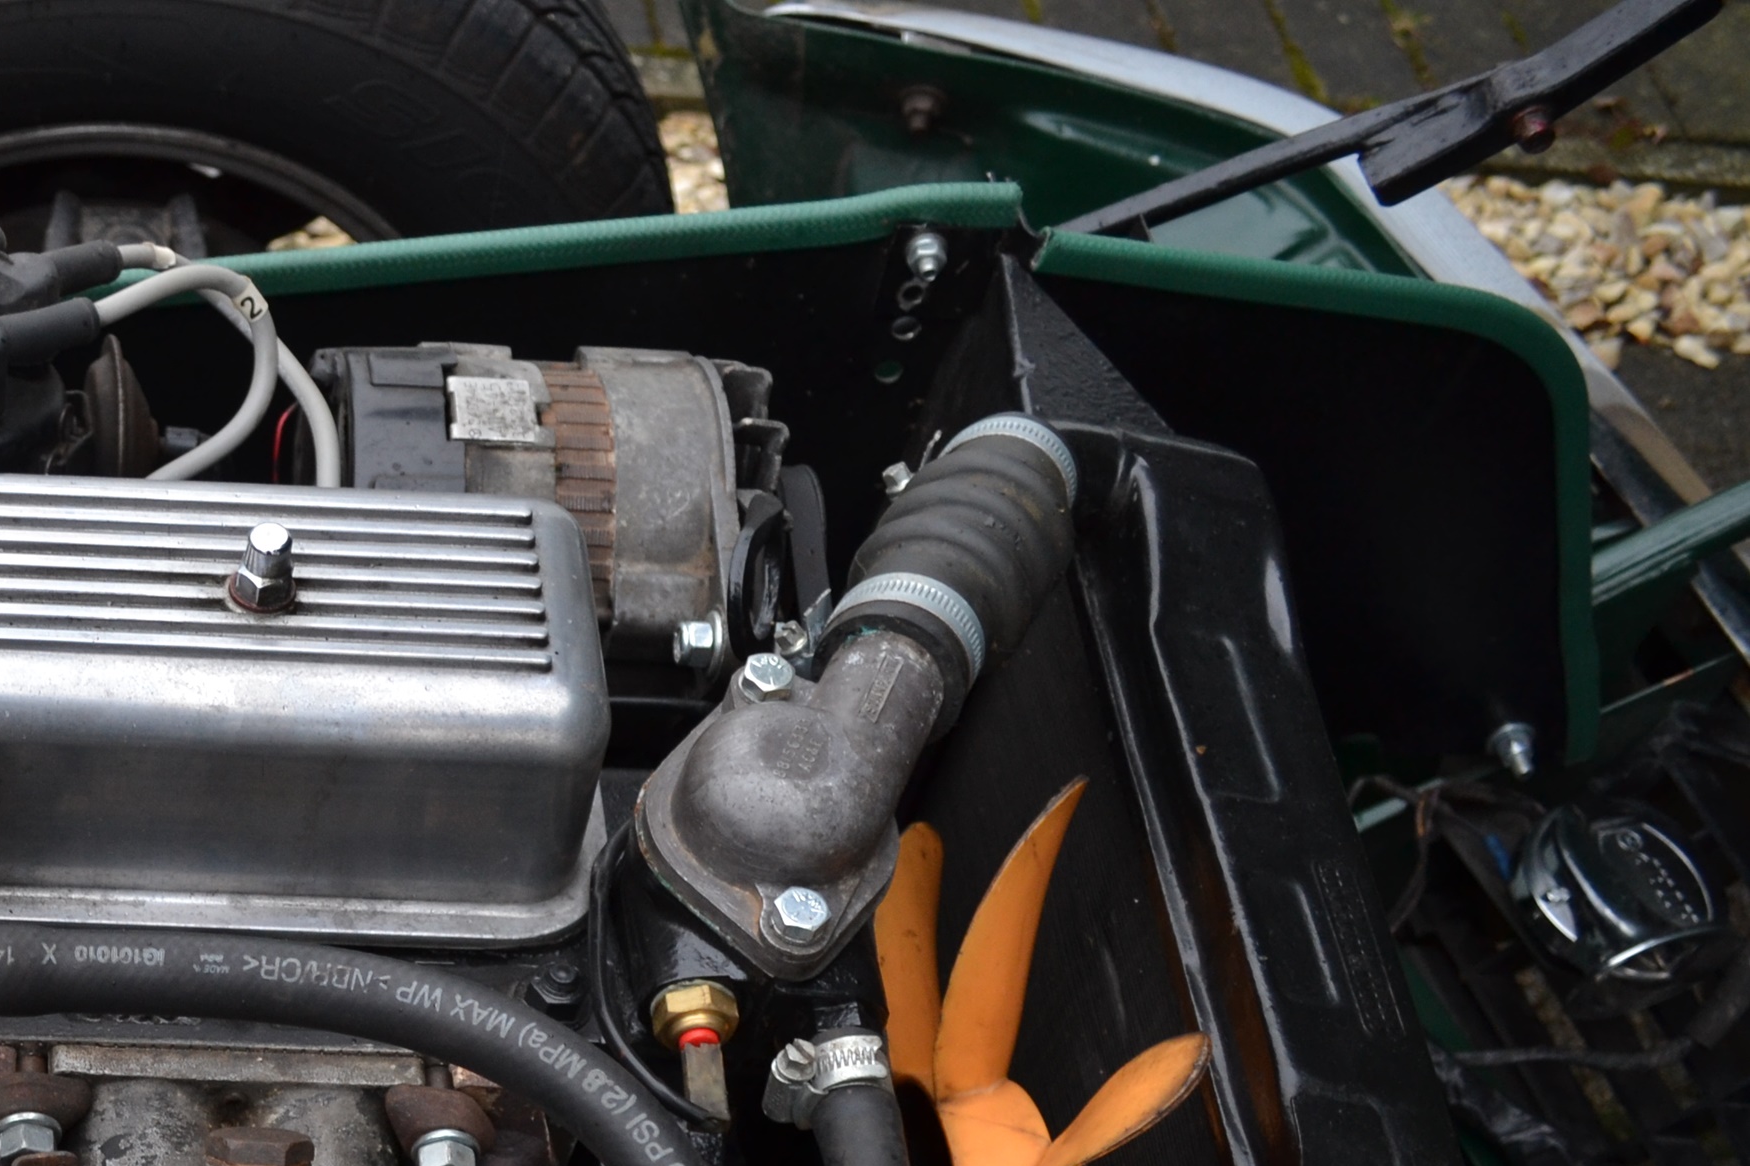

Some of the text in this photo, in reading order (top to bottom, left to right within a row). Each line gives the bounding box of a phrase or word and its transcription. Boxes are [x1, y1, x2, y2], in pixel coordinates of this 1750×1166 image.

[240, 295, 263, 320] 2
[41, 942, 58, 966] X
[395, 979, 444, 1013] WP
[449, 993, 516, 1040] MAX
[517, 1022, 588, 1079] MPa)
[582, 1068, 638, 1116] (2.8
[625, 1113, 675, 1163] PSI
